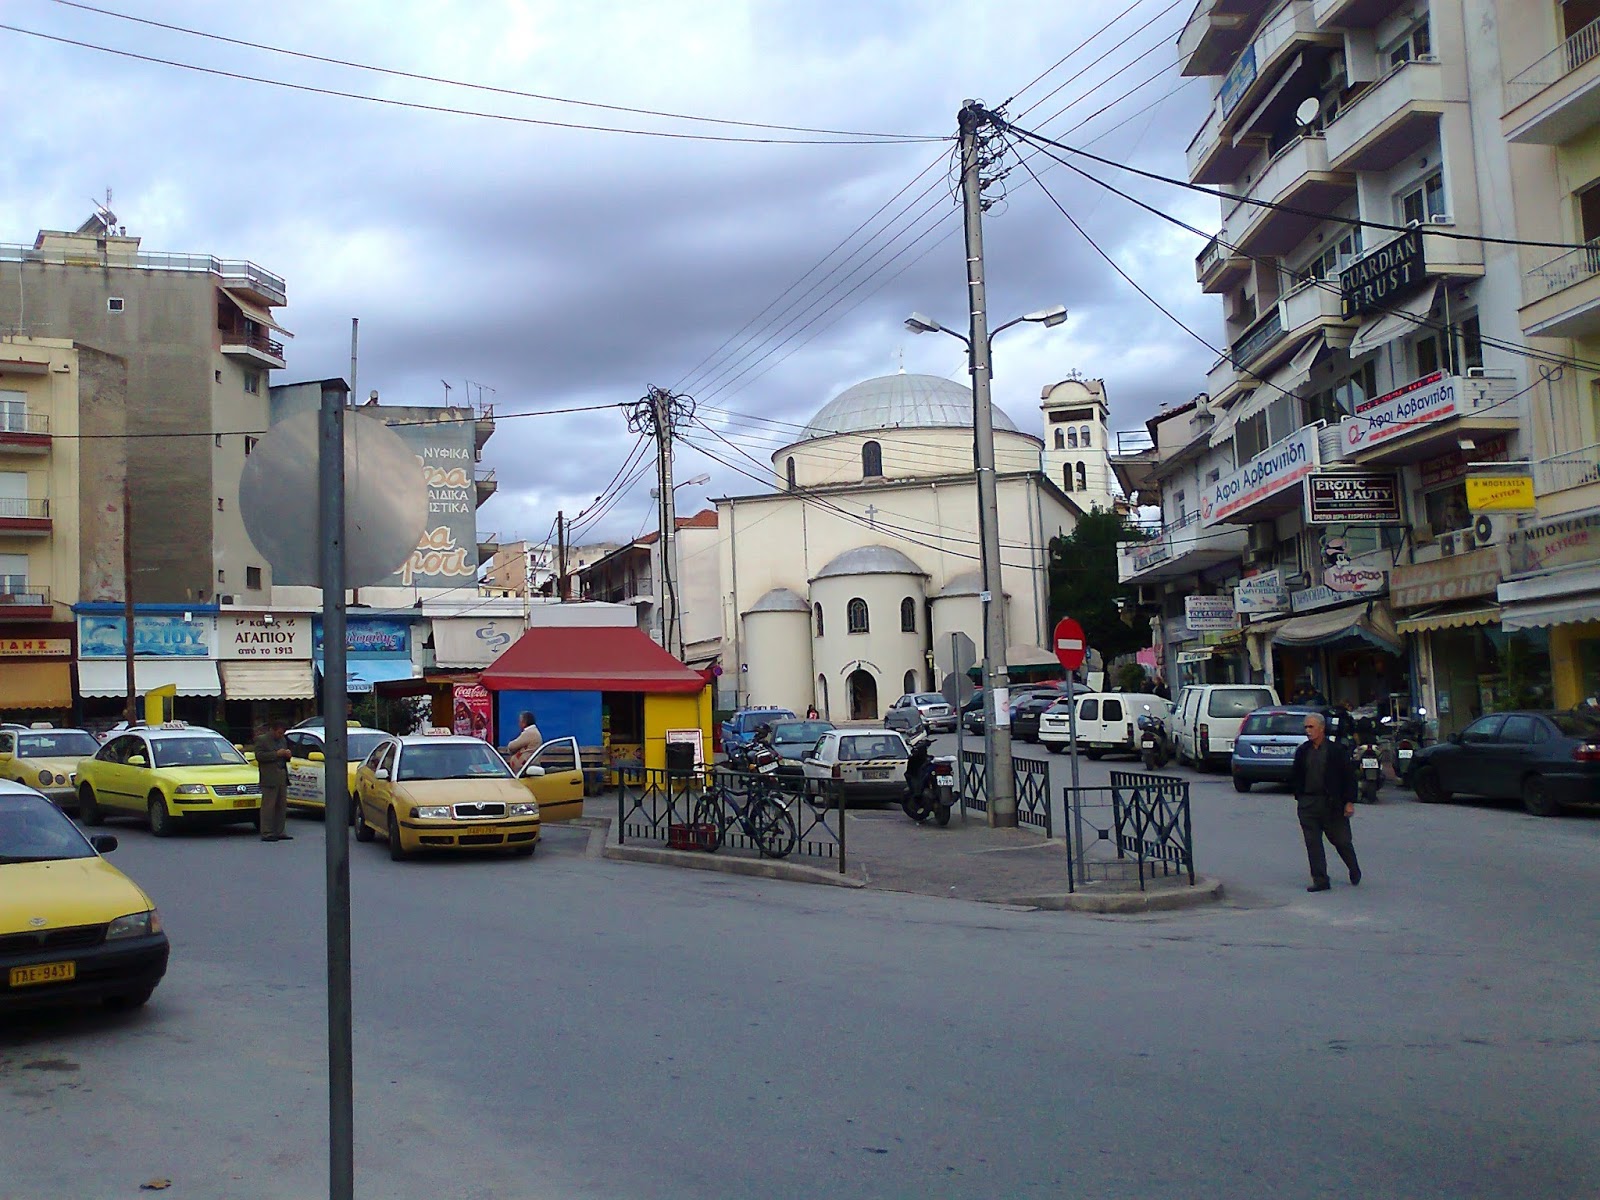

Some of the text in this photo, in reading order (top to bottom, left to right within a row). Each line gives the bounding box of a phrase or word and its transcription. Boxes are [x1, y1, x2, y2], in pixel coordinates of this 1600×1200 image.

[1341, 234, 1417, 292] GUARDIAN
[1353, 262, 1412, 310] TRUST
[424, 447, 470, 460] ΝΥΦΙΚΑ
[1315, 480, 1366, 490] EROTIC
[428, 489, 469, 500] ΑΙΔΙΚΑ
[1334, 489, 1391, 500] BEAUTY
[429, 502, 470, 513] ΙΣΤΙΚΑ
[235, 632, 296, 643] ΑΓΑΠΙΟΥ
[238, 646, 257, 655] από
[274, 646, 293, 655] 1913
